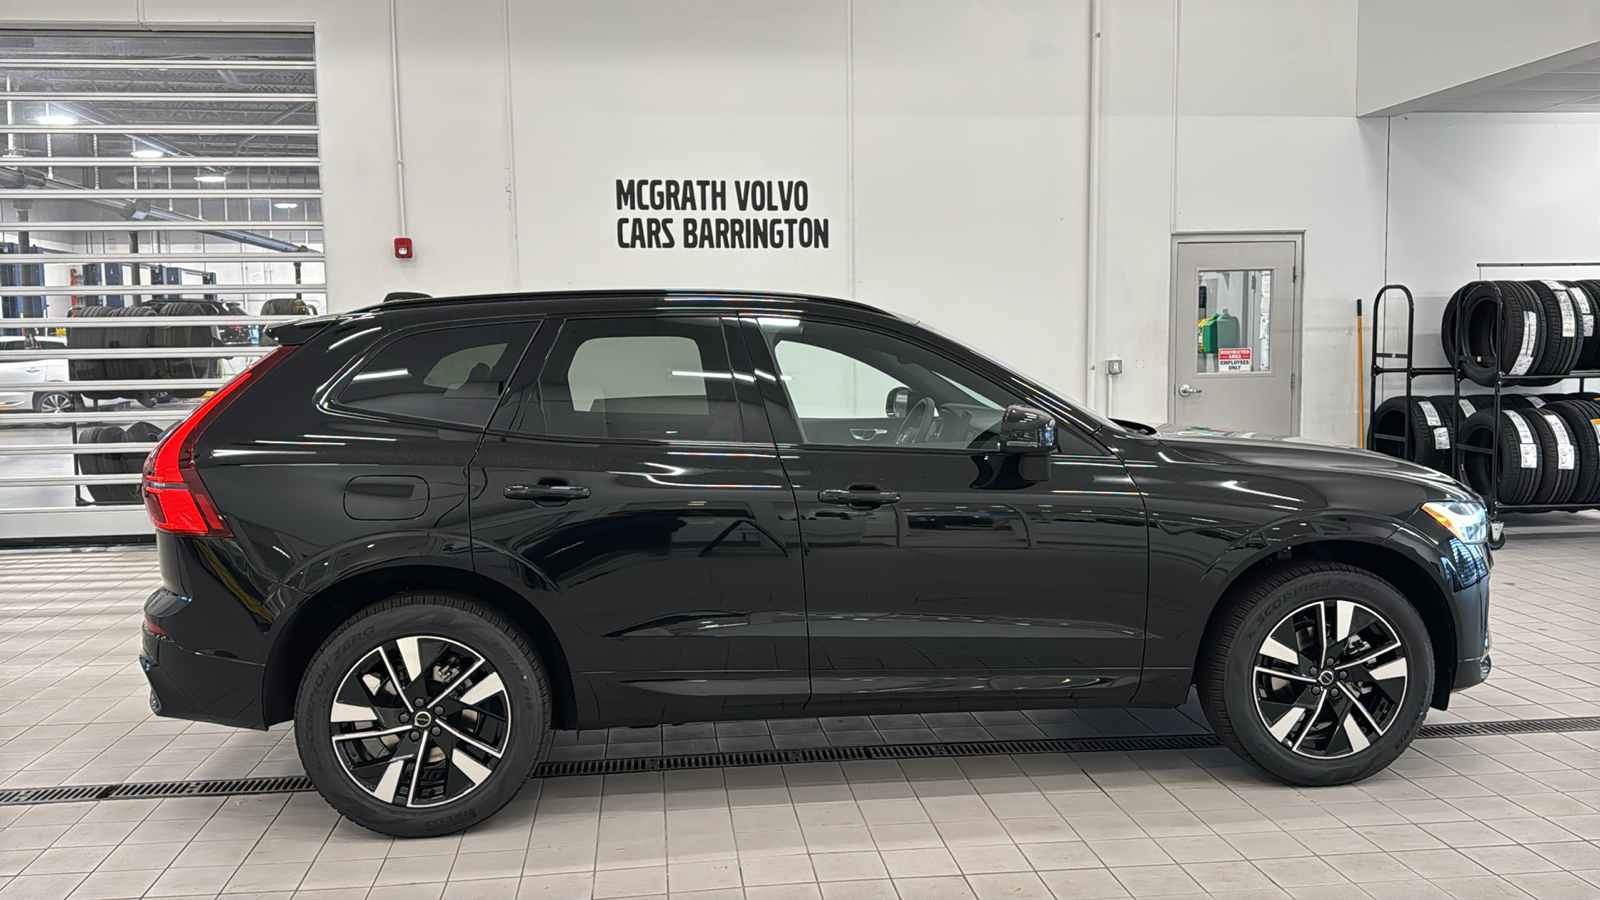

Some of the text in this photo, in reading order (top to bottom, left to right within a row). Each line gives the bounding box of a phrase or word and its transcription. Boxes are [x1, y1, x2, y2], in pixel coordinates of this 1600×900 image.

[615, 179, 809, 211] MCGRATH VOLVO
[616, 217, 829, 249] CARS BARRINGTON
[1256, 579, 1332, 626] SCORPION
